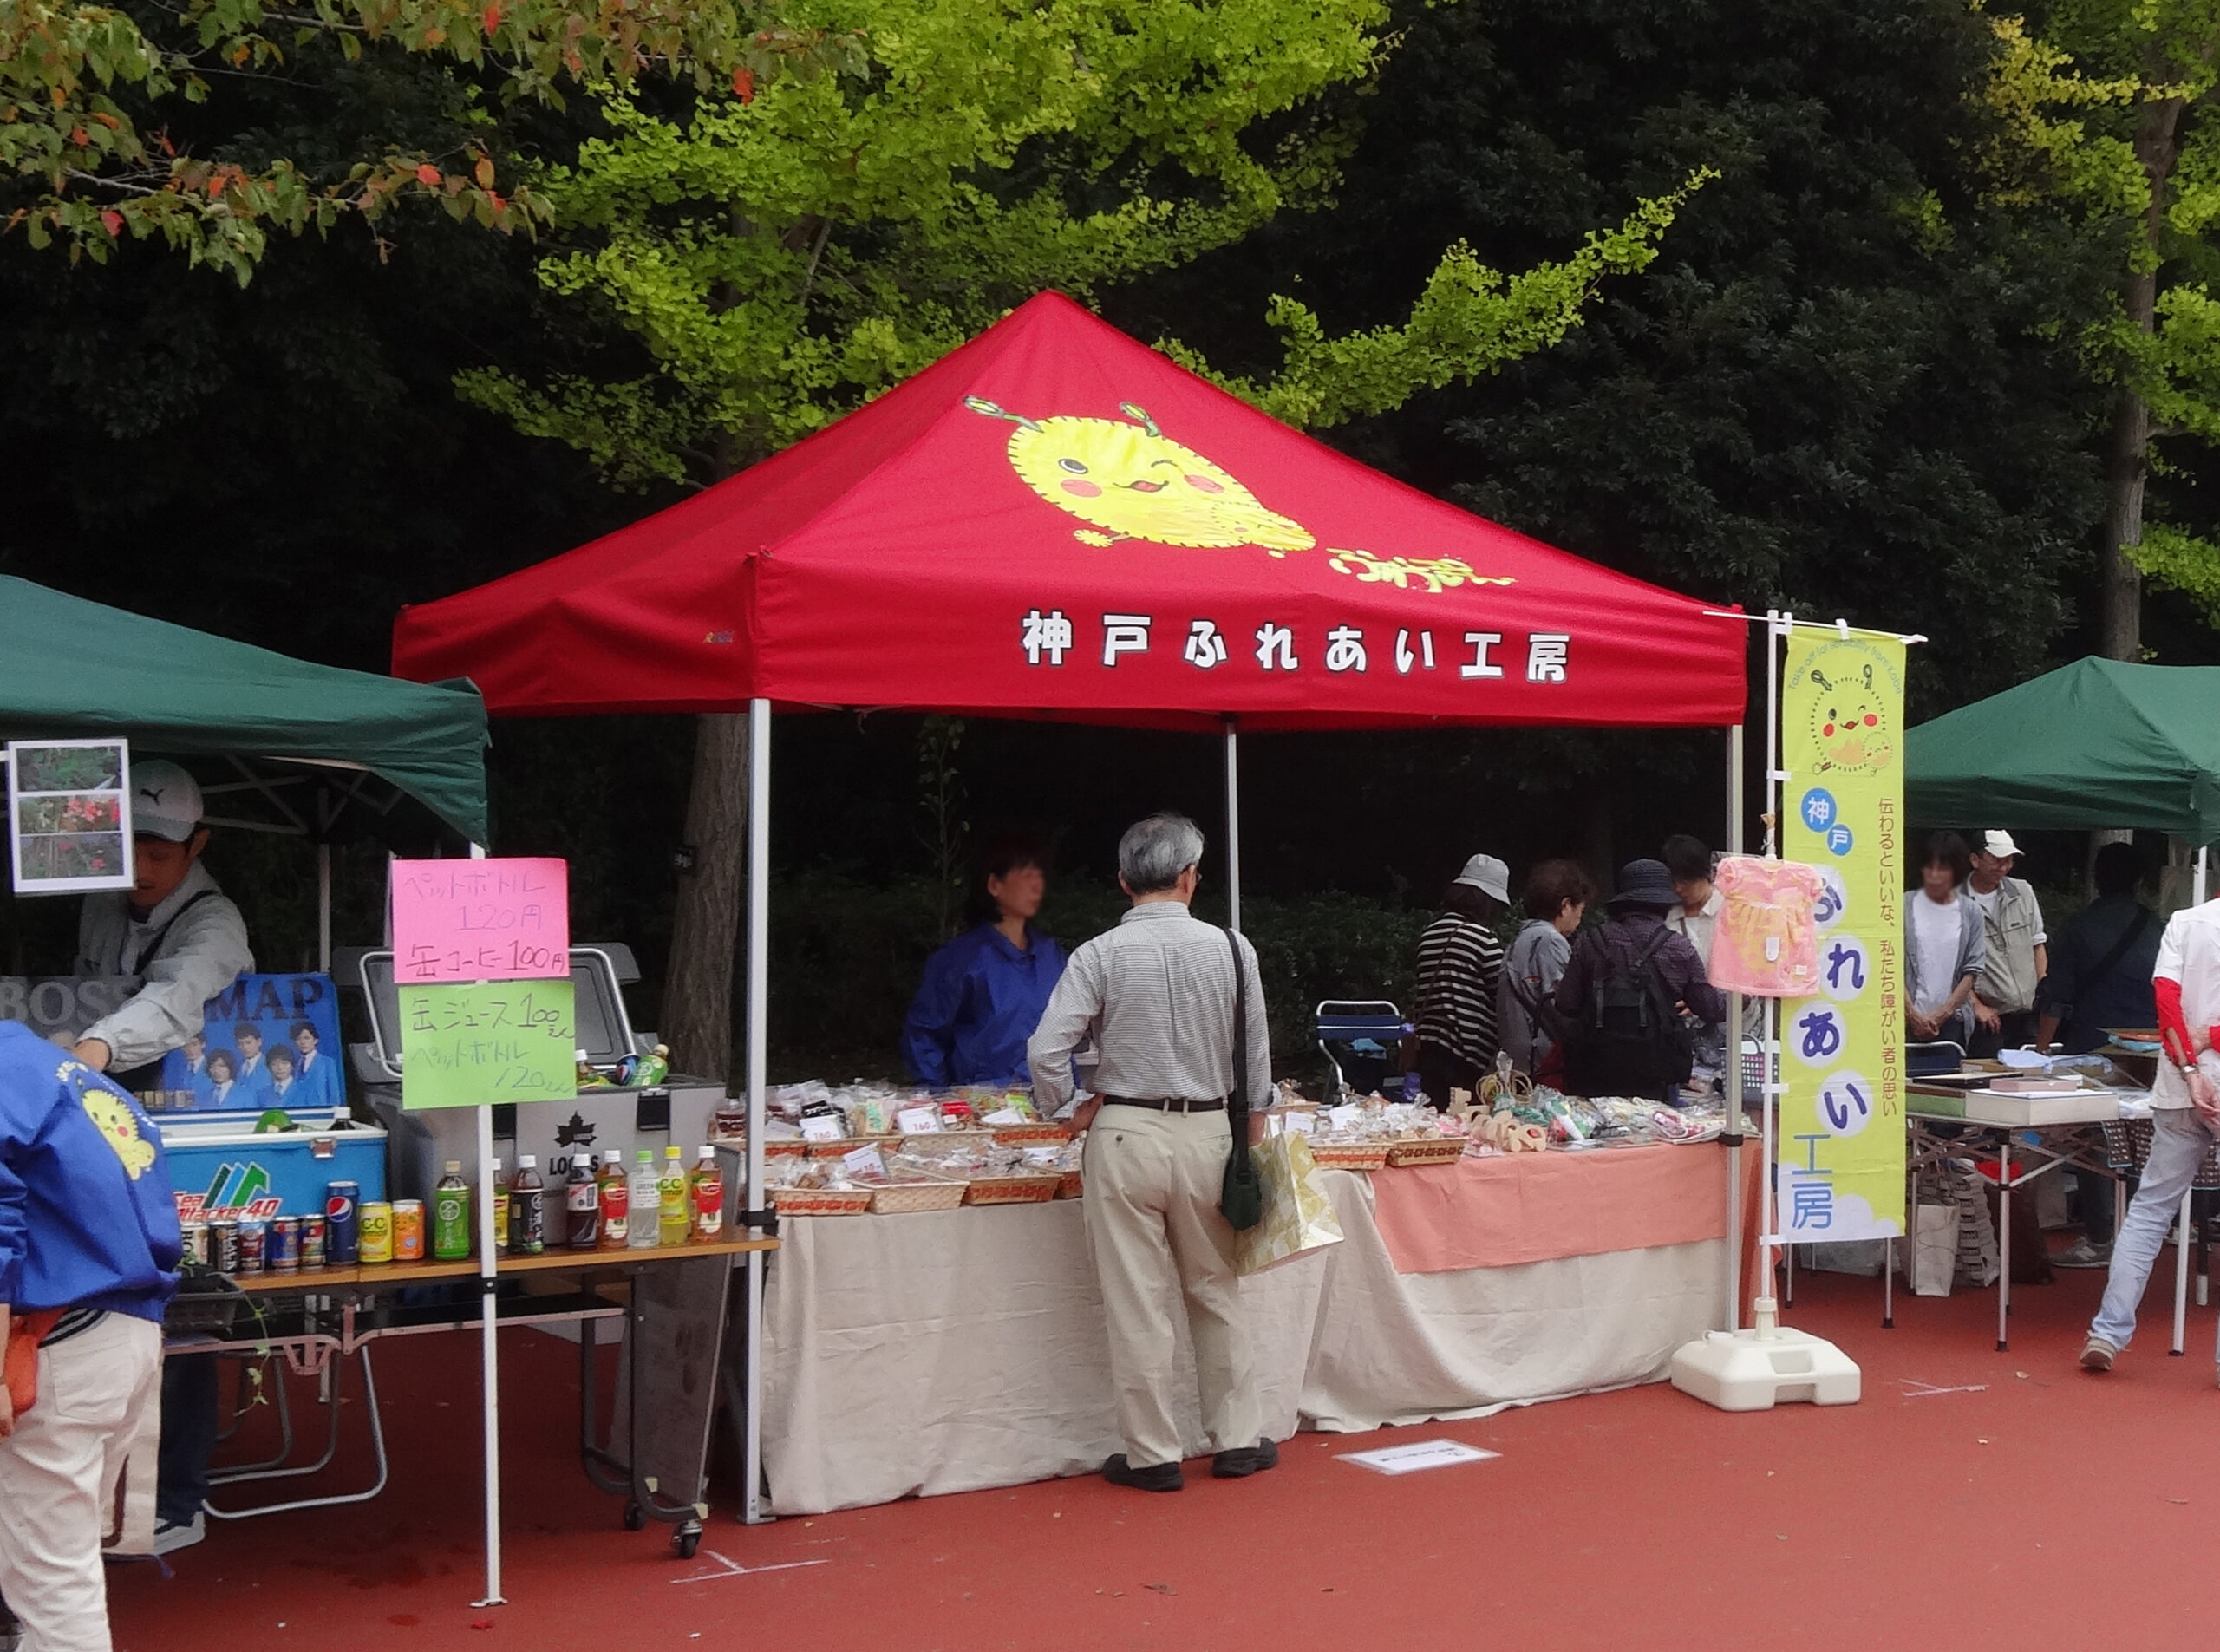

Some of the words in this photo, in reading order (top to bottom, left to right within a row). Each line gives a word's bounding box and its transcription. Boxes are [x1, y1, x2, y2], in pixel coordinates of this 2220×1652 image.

[1022, 610, 1570, 683] 神戸ふれあい工房
[404, 870, 546, 899] ペットボトル
[454, 904, 542, 931] 120円
[203, 979, 323, 1021] MAP
[410, 1039, 531, 1071] ペットボトル
[549, 1155, 599, 1175] LOS
